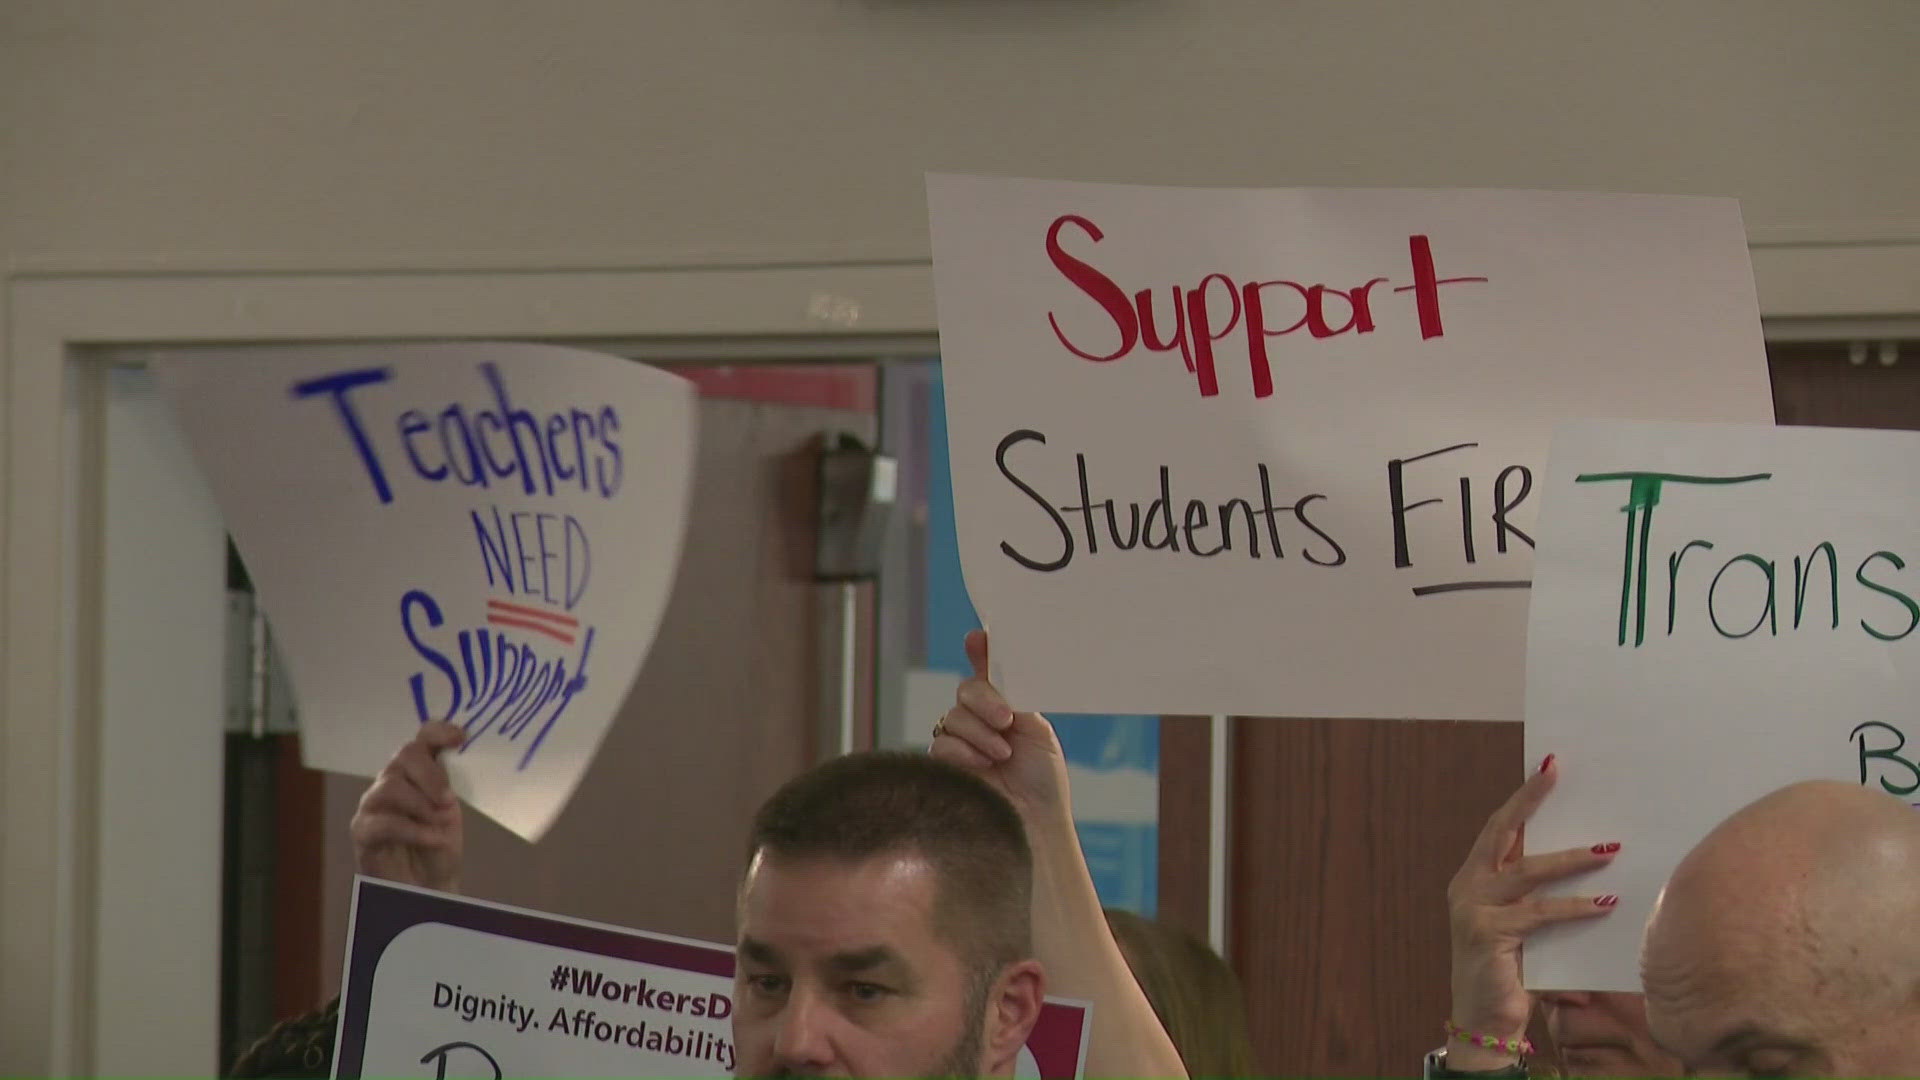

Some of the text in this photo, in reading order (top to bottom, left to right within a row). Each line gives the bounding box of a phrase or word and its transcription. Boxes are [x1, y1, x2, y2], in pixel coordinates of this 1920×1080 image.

[1046, 214, 1489, 398] Support
[292, 361, 624, 505] Teachers
[996, 429, 1346, 571] Students
[471, 505, 591, 611] NEED
[401, 590, 596, 772] Support
[433, 981, 540, 1030] Dignity.
